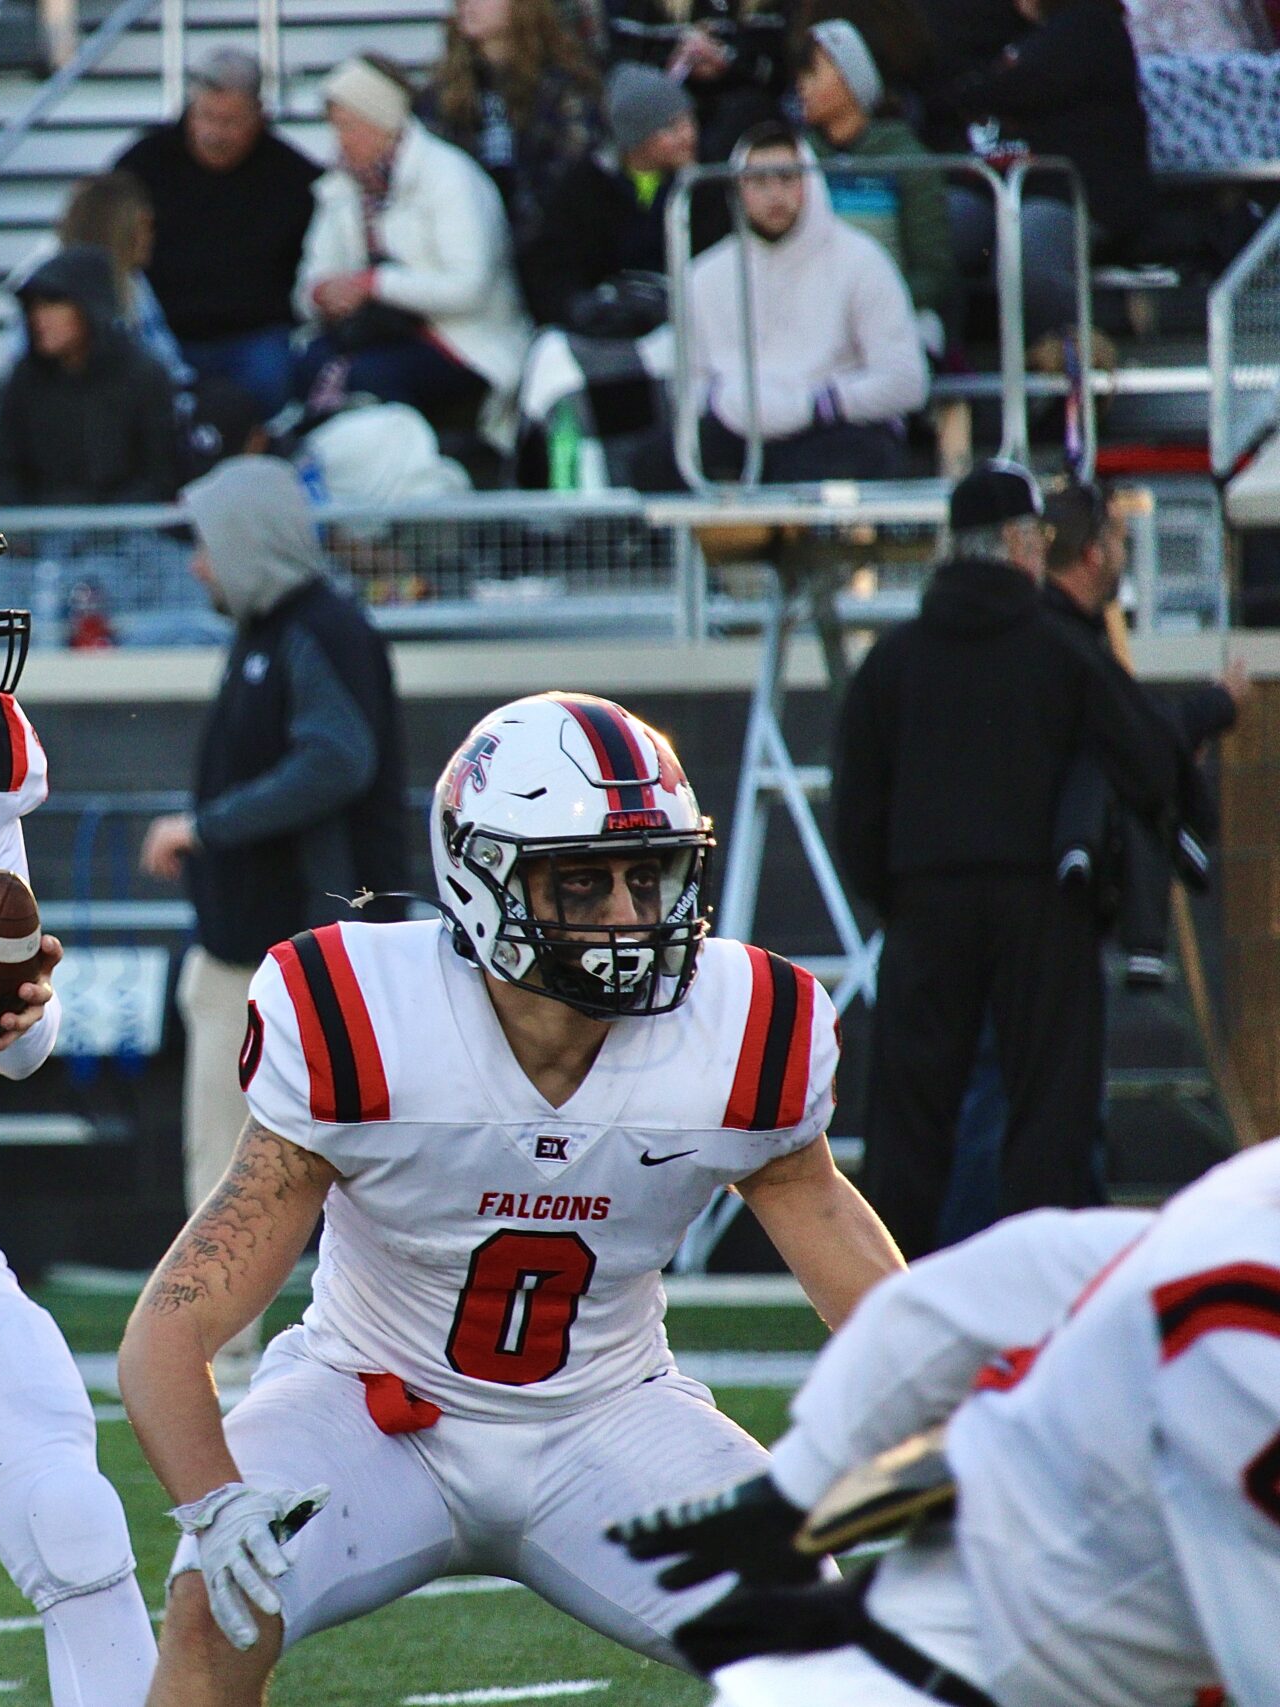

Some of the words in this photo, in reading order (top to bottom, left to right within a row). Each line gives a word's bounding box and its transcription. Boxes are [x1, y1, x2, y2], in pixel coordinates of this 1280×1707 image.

[607, 811, 663, 830] FAMILY
[665, 881, 700, 924] Riddell
[477, 1192, 611, 1221] FALCONS
[444, 1227, 597, 1386] 0
